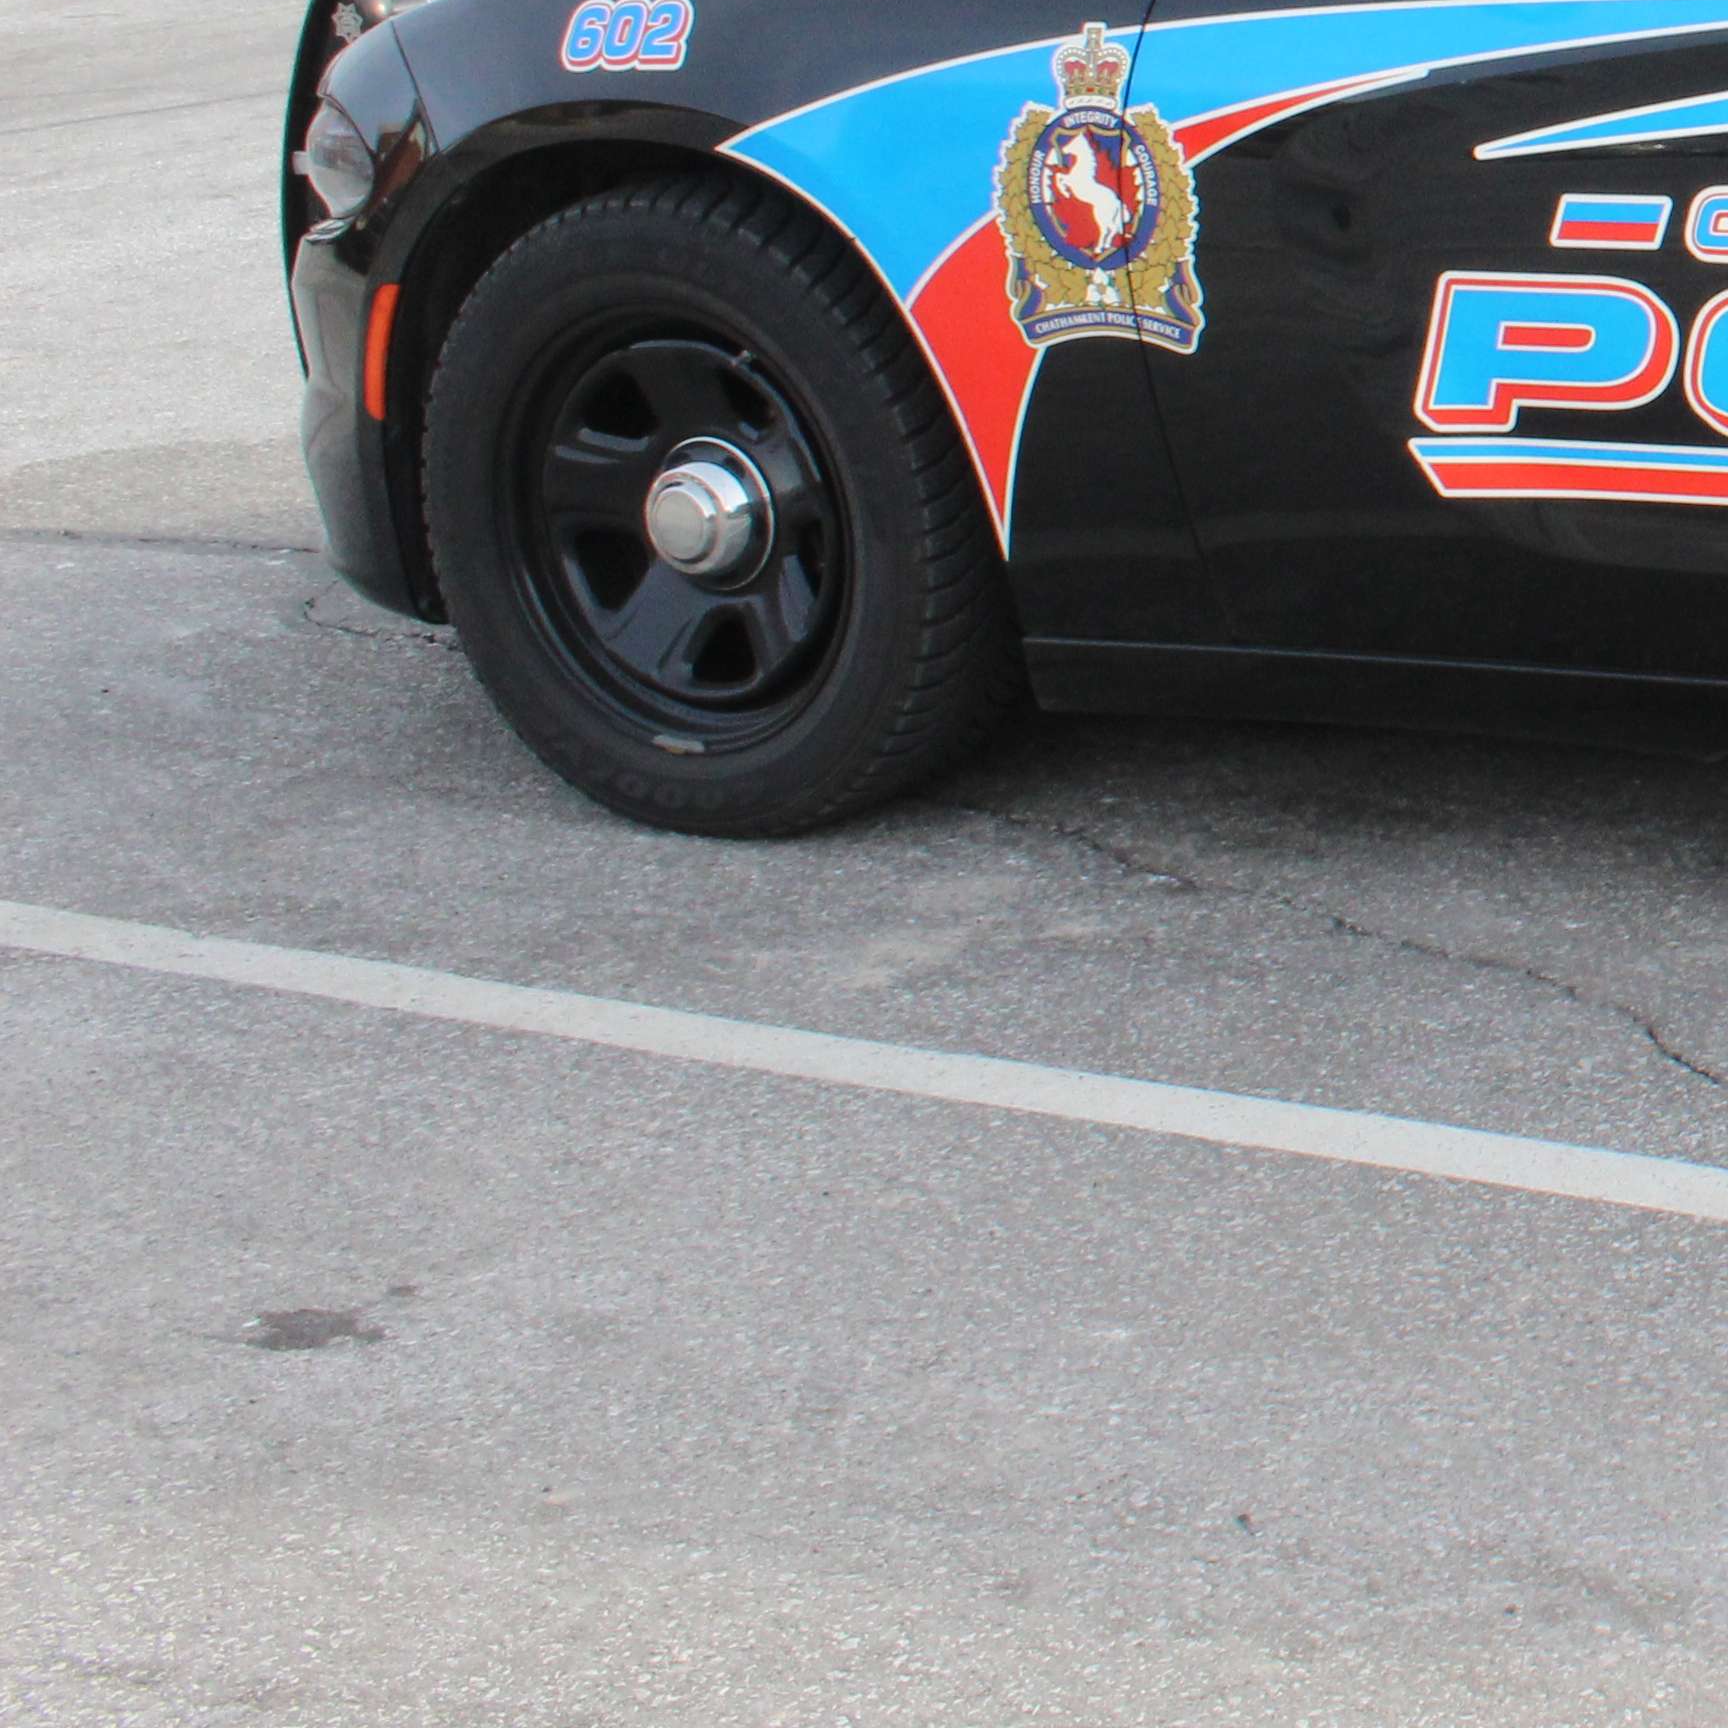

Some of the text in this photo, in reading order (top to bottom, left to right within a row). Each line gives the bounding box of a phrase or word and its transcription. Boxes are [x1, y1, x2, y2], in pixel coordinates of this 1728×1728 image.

[1064, 111, 1118, 128] INTEGRITY
[1031, 150, 1045, 204] HONOUR
[1135, 145, 1157, 205] COURAGE
[1142, 317, 1182, 339] SERVICE
